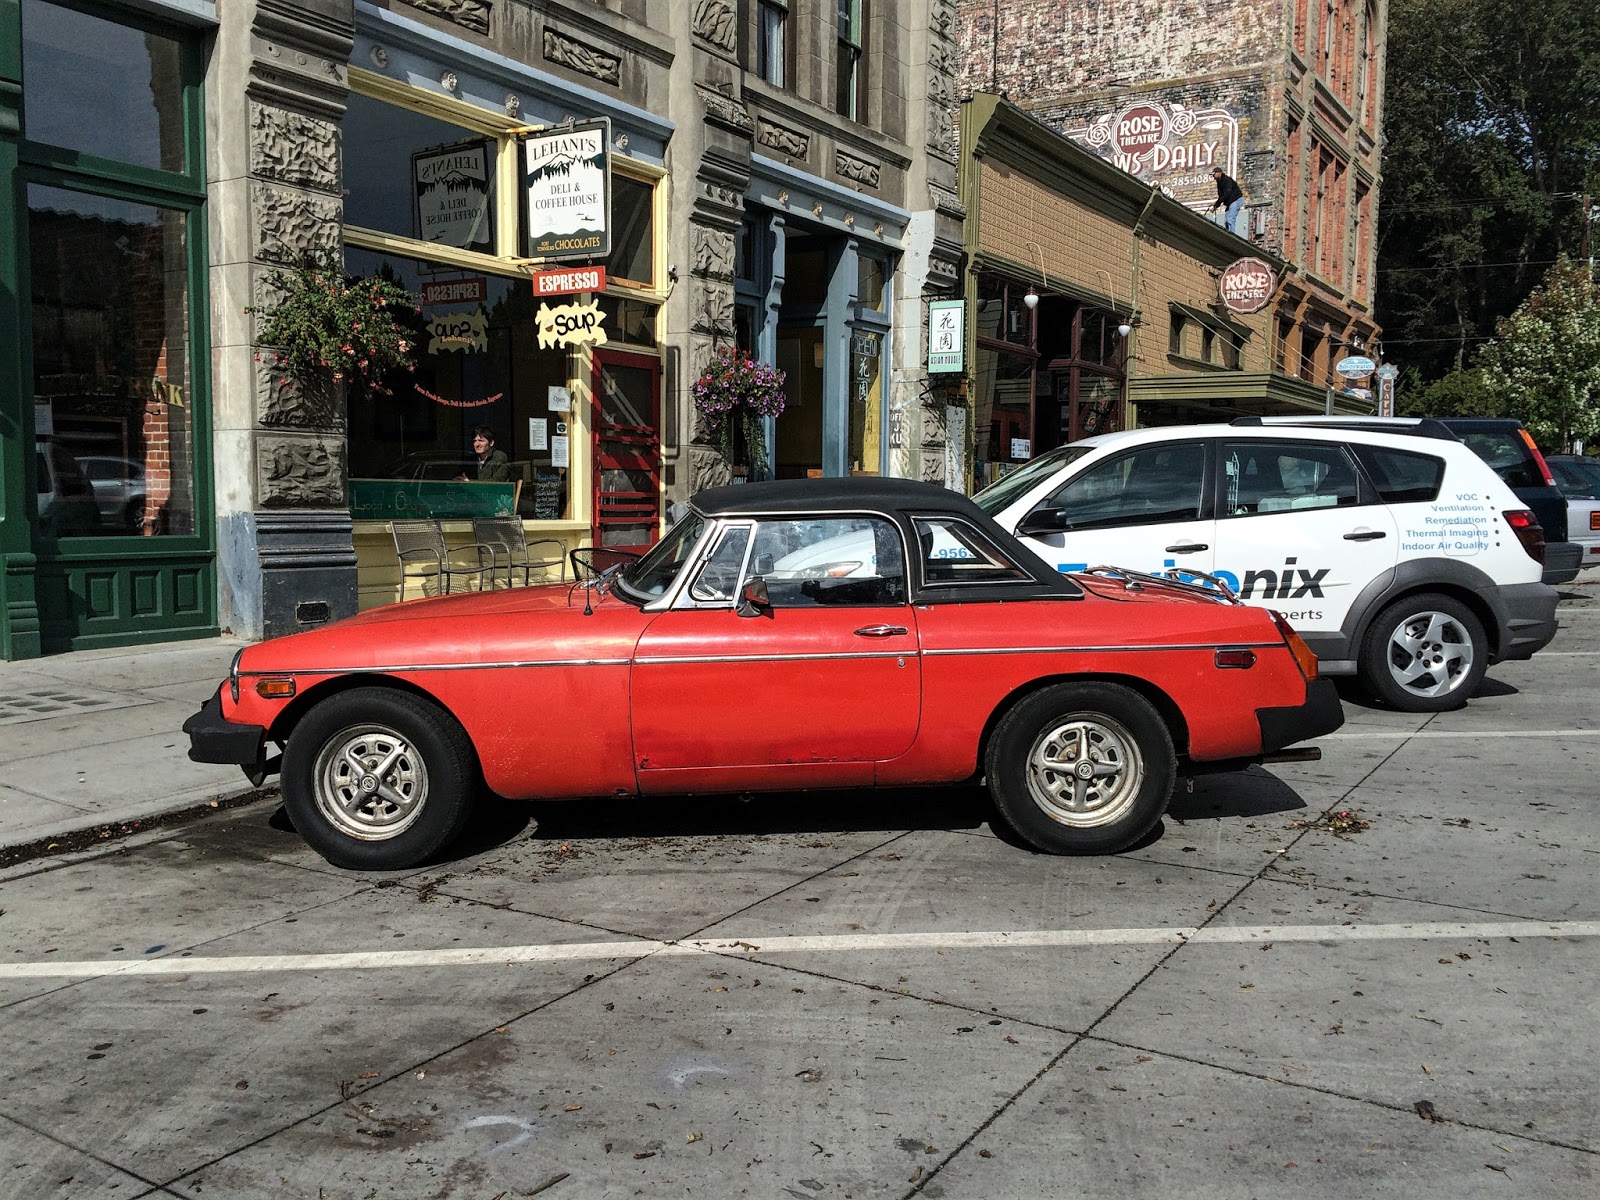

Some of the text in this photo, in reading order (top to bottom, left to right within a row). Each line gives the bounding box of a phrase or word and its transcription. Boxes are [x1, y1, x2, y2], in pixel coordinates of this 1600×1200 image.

[1119, 116, 1162, 136] ROSE
[1120, 133, 1160, 146] THEATRE
[533, 138, 597, 160] LEHANI'S
[1153, 141, 1218, 171] DAILY
[550, 182, 580, 195] DELI &
[535, 193, 598, 210] COFFEE HOUSE
[554, 237, 600, 250] CHOCOLATES
[539, 271, 599, 293] ESPRESSO
[1225, 272, 1269, 290] ROSE
[555, 312, 595, 336] Soup
[853, 336, 877, 356] OPEN
[553, 395, 566, 404] Open
[1425, 517, 1487, 525] Remediation
[1406, 529, 1489, 538] Thermal Imaging
[1402, 541, 1489, 551] Indoor Air Quality
